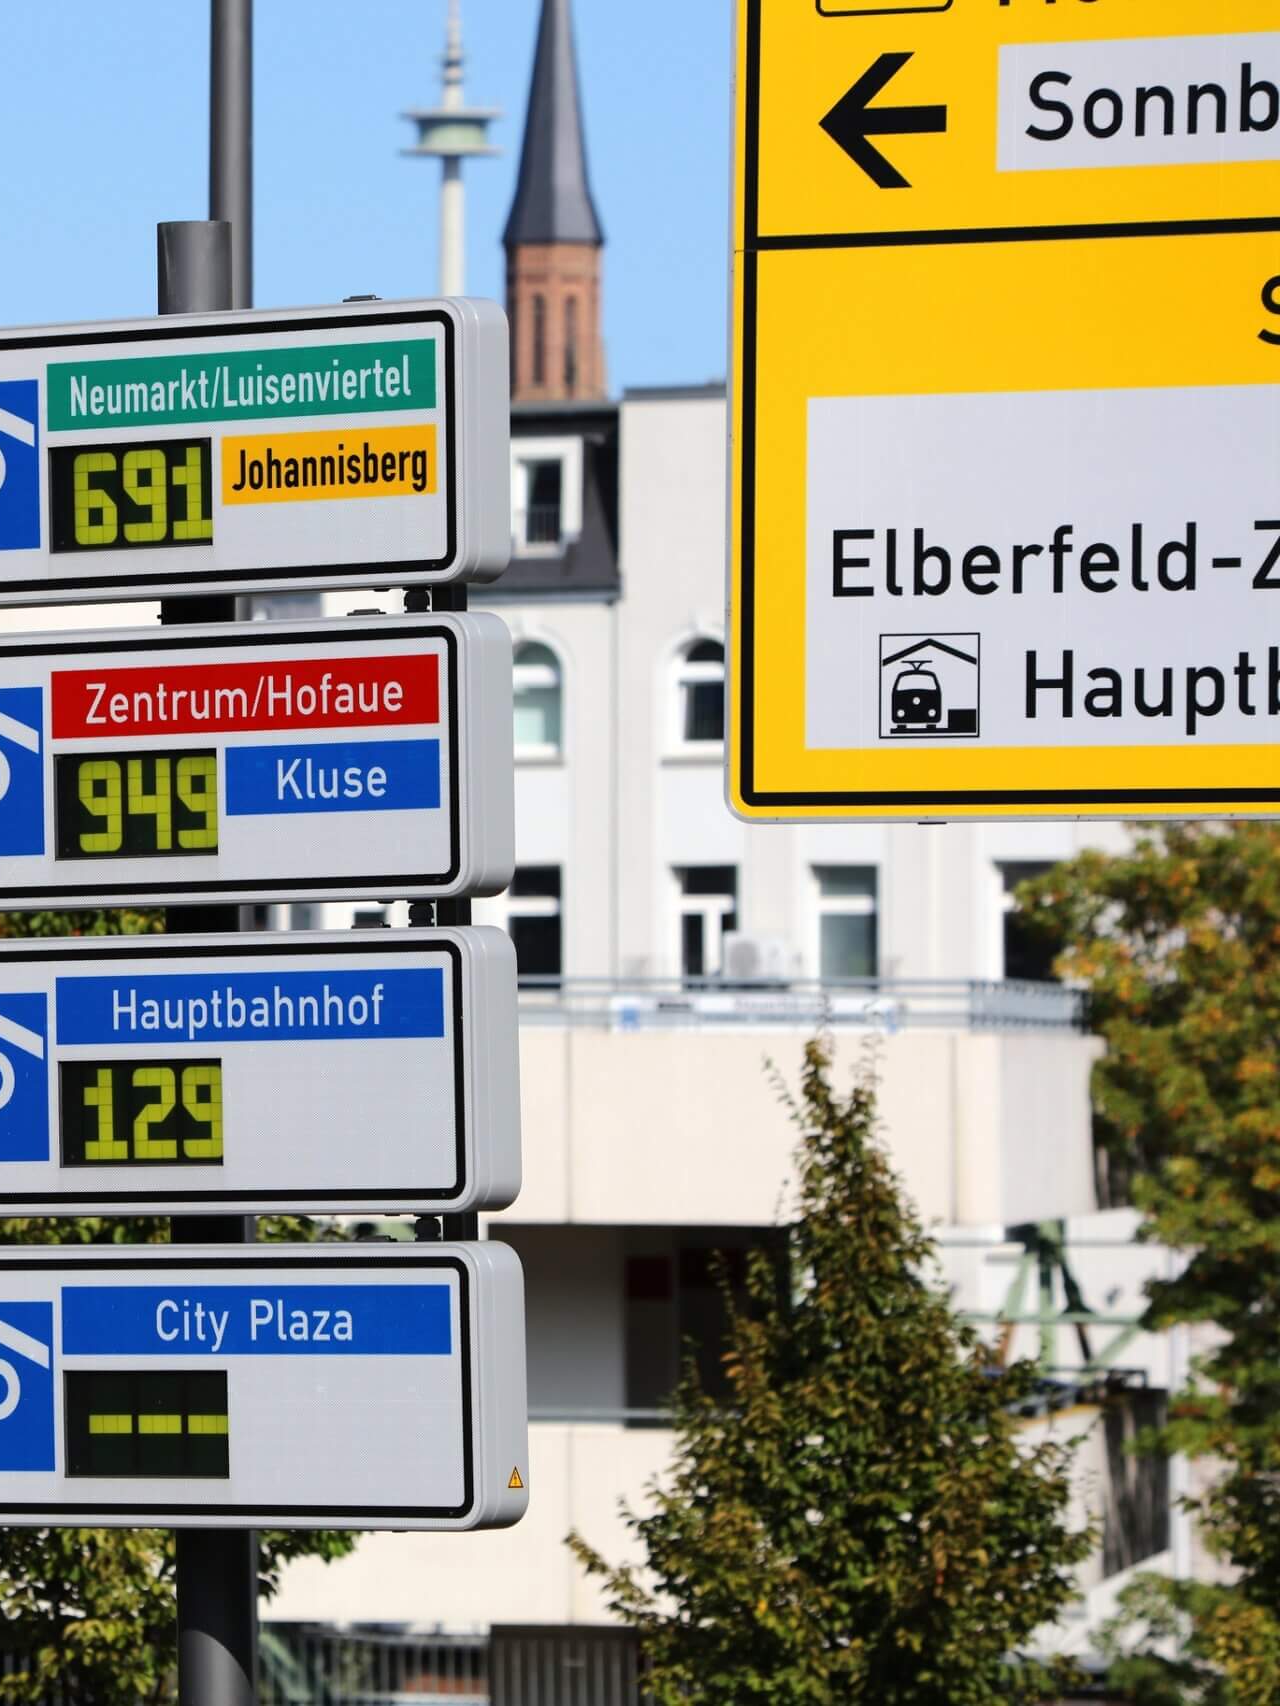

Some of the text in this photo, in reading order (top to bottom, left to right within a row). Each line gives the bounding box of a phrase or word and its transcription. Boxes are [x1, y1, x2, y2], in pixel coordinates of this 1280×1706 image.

[1024, 62, 1280, 141] Sonnb
[69, 354, 412, 418] Neumarkt/Luisenviertel
[73, 447, 212, 545] 691
[232, 442, 428, 493] Johannisberg
[86, 673, 404, 725] Zentrum/Hofaue
[79, 758, 218, 852] 949
[277, 758, 388, 800] Kluse
[112, 983, 384, 1040] Hauptbahnhof
[84, 1067, 223, 1160] 129
[156, 1300, 354, 1352] City Plaza
